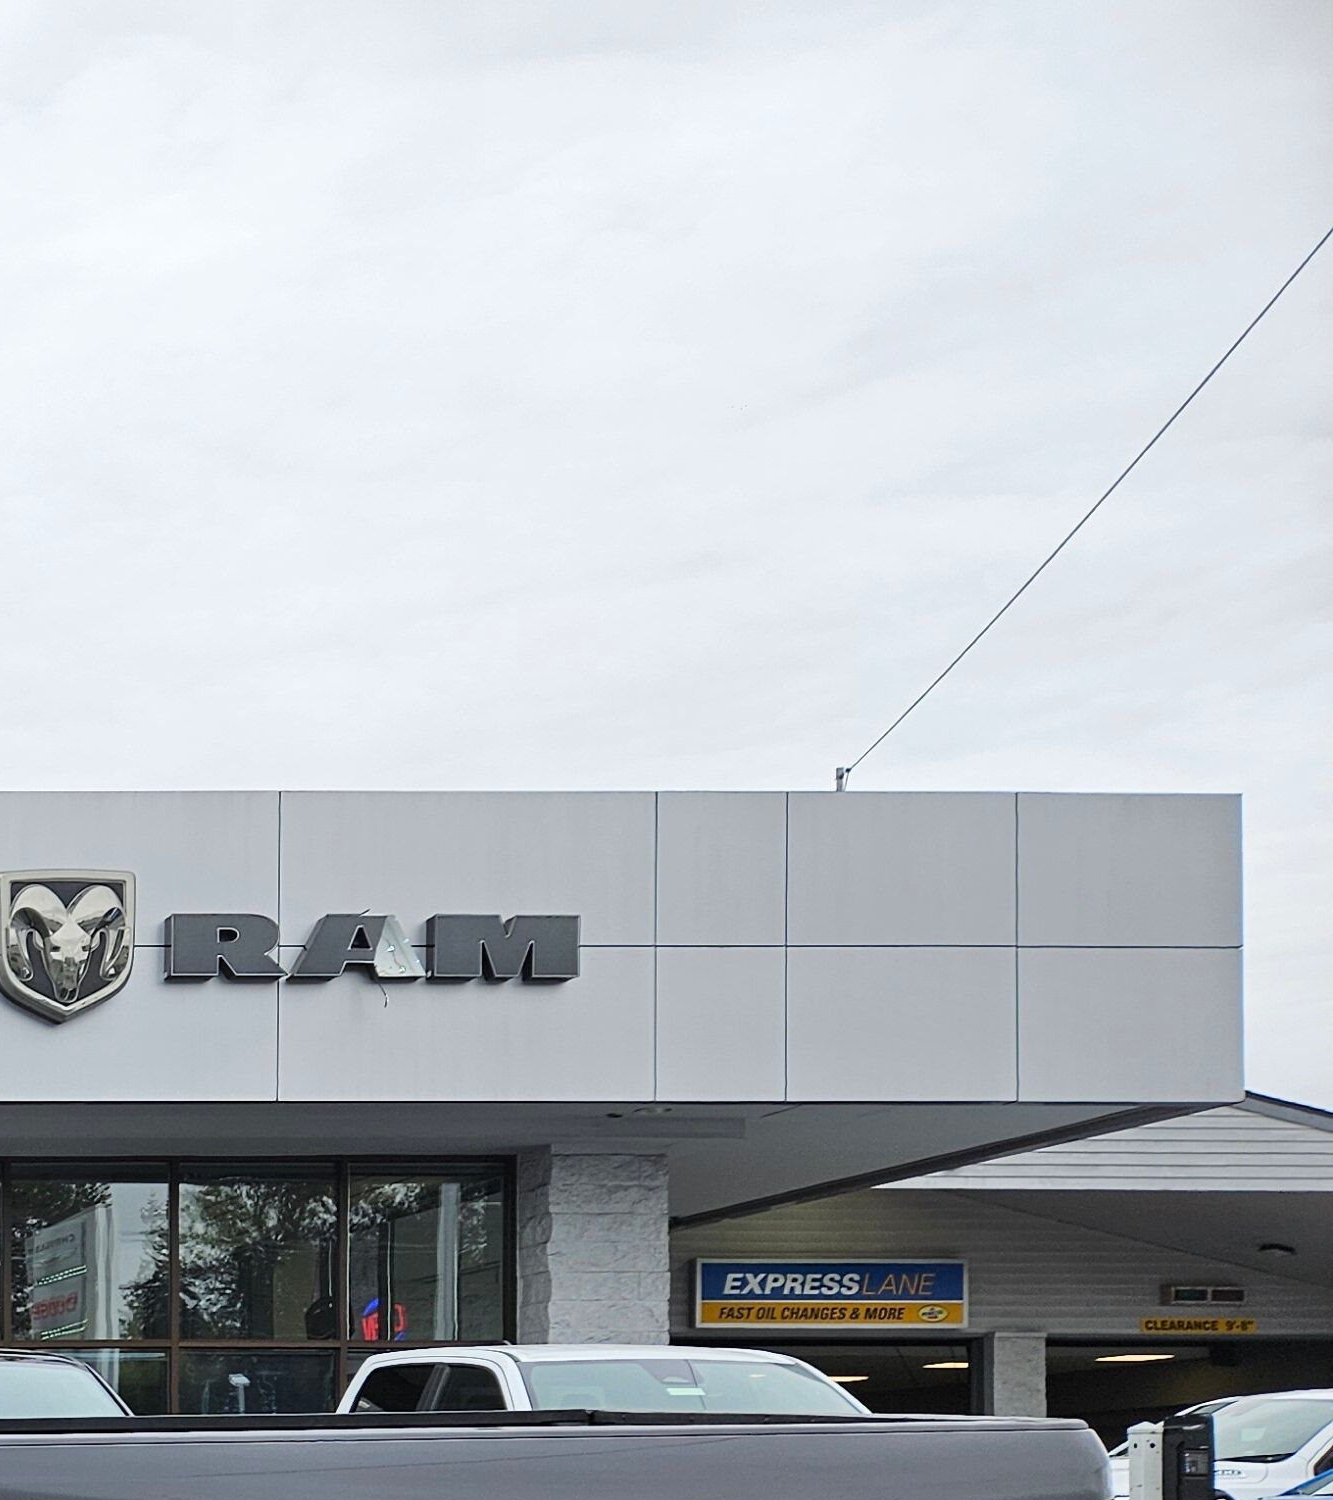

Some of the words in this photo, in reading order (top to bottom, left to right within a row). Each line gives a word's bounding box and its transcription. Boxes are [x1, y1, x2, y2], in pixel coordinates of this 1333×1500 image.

[163, 909, 583, 986] RAM
[718, 1306, 754, 1320] FAST
[756, 1306, 776, 1320] OIL
[780, 1306, 847, 1321] CHANGES
[849, 1306, 861, 1320] &
[864, 1306, 906, 1320] MORE
[1144, 1320, 1219, 1331] CLEARANCE
